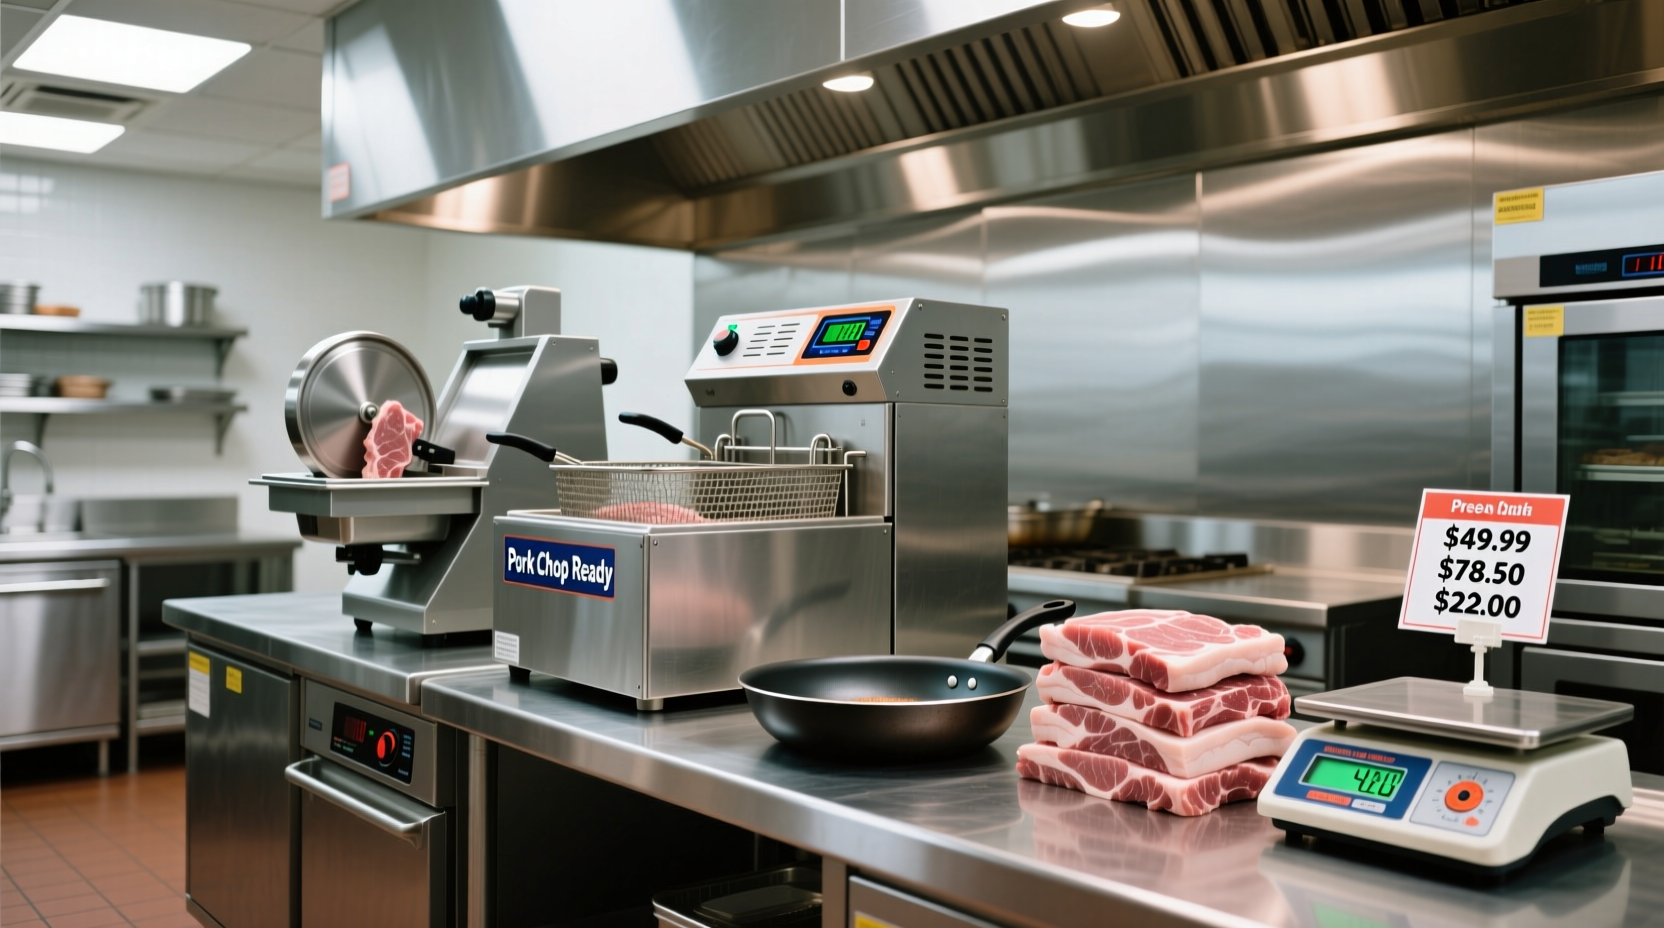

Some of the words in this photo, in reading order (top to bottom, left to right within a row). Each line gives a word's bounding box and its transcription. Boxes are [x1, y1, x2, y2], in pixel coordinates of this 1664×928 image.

[1443, 523, 1531, 553] $49.99
[508, 547, 535, 575] Pork
[537, 551, 569, 585] Chop
[572, 555, 613, 591] Ready
[1437, 555, 1525, 586] $78.50
[1433, 587, 1521, 618] $22.00
